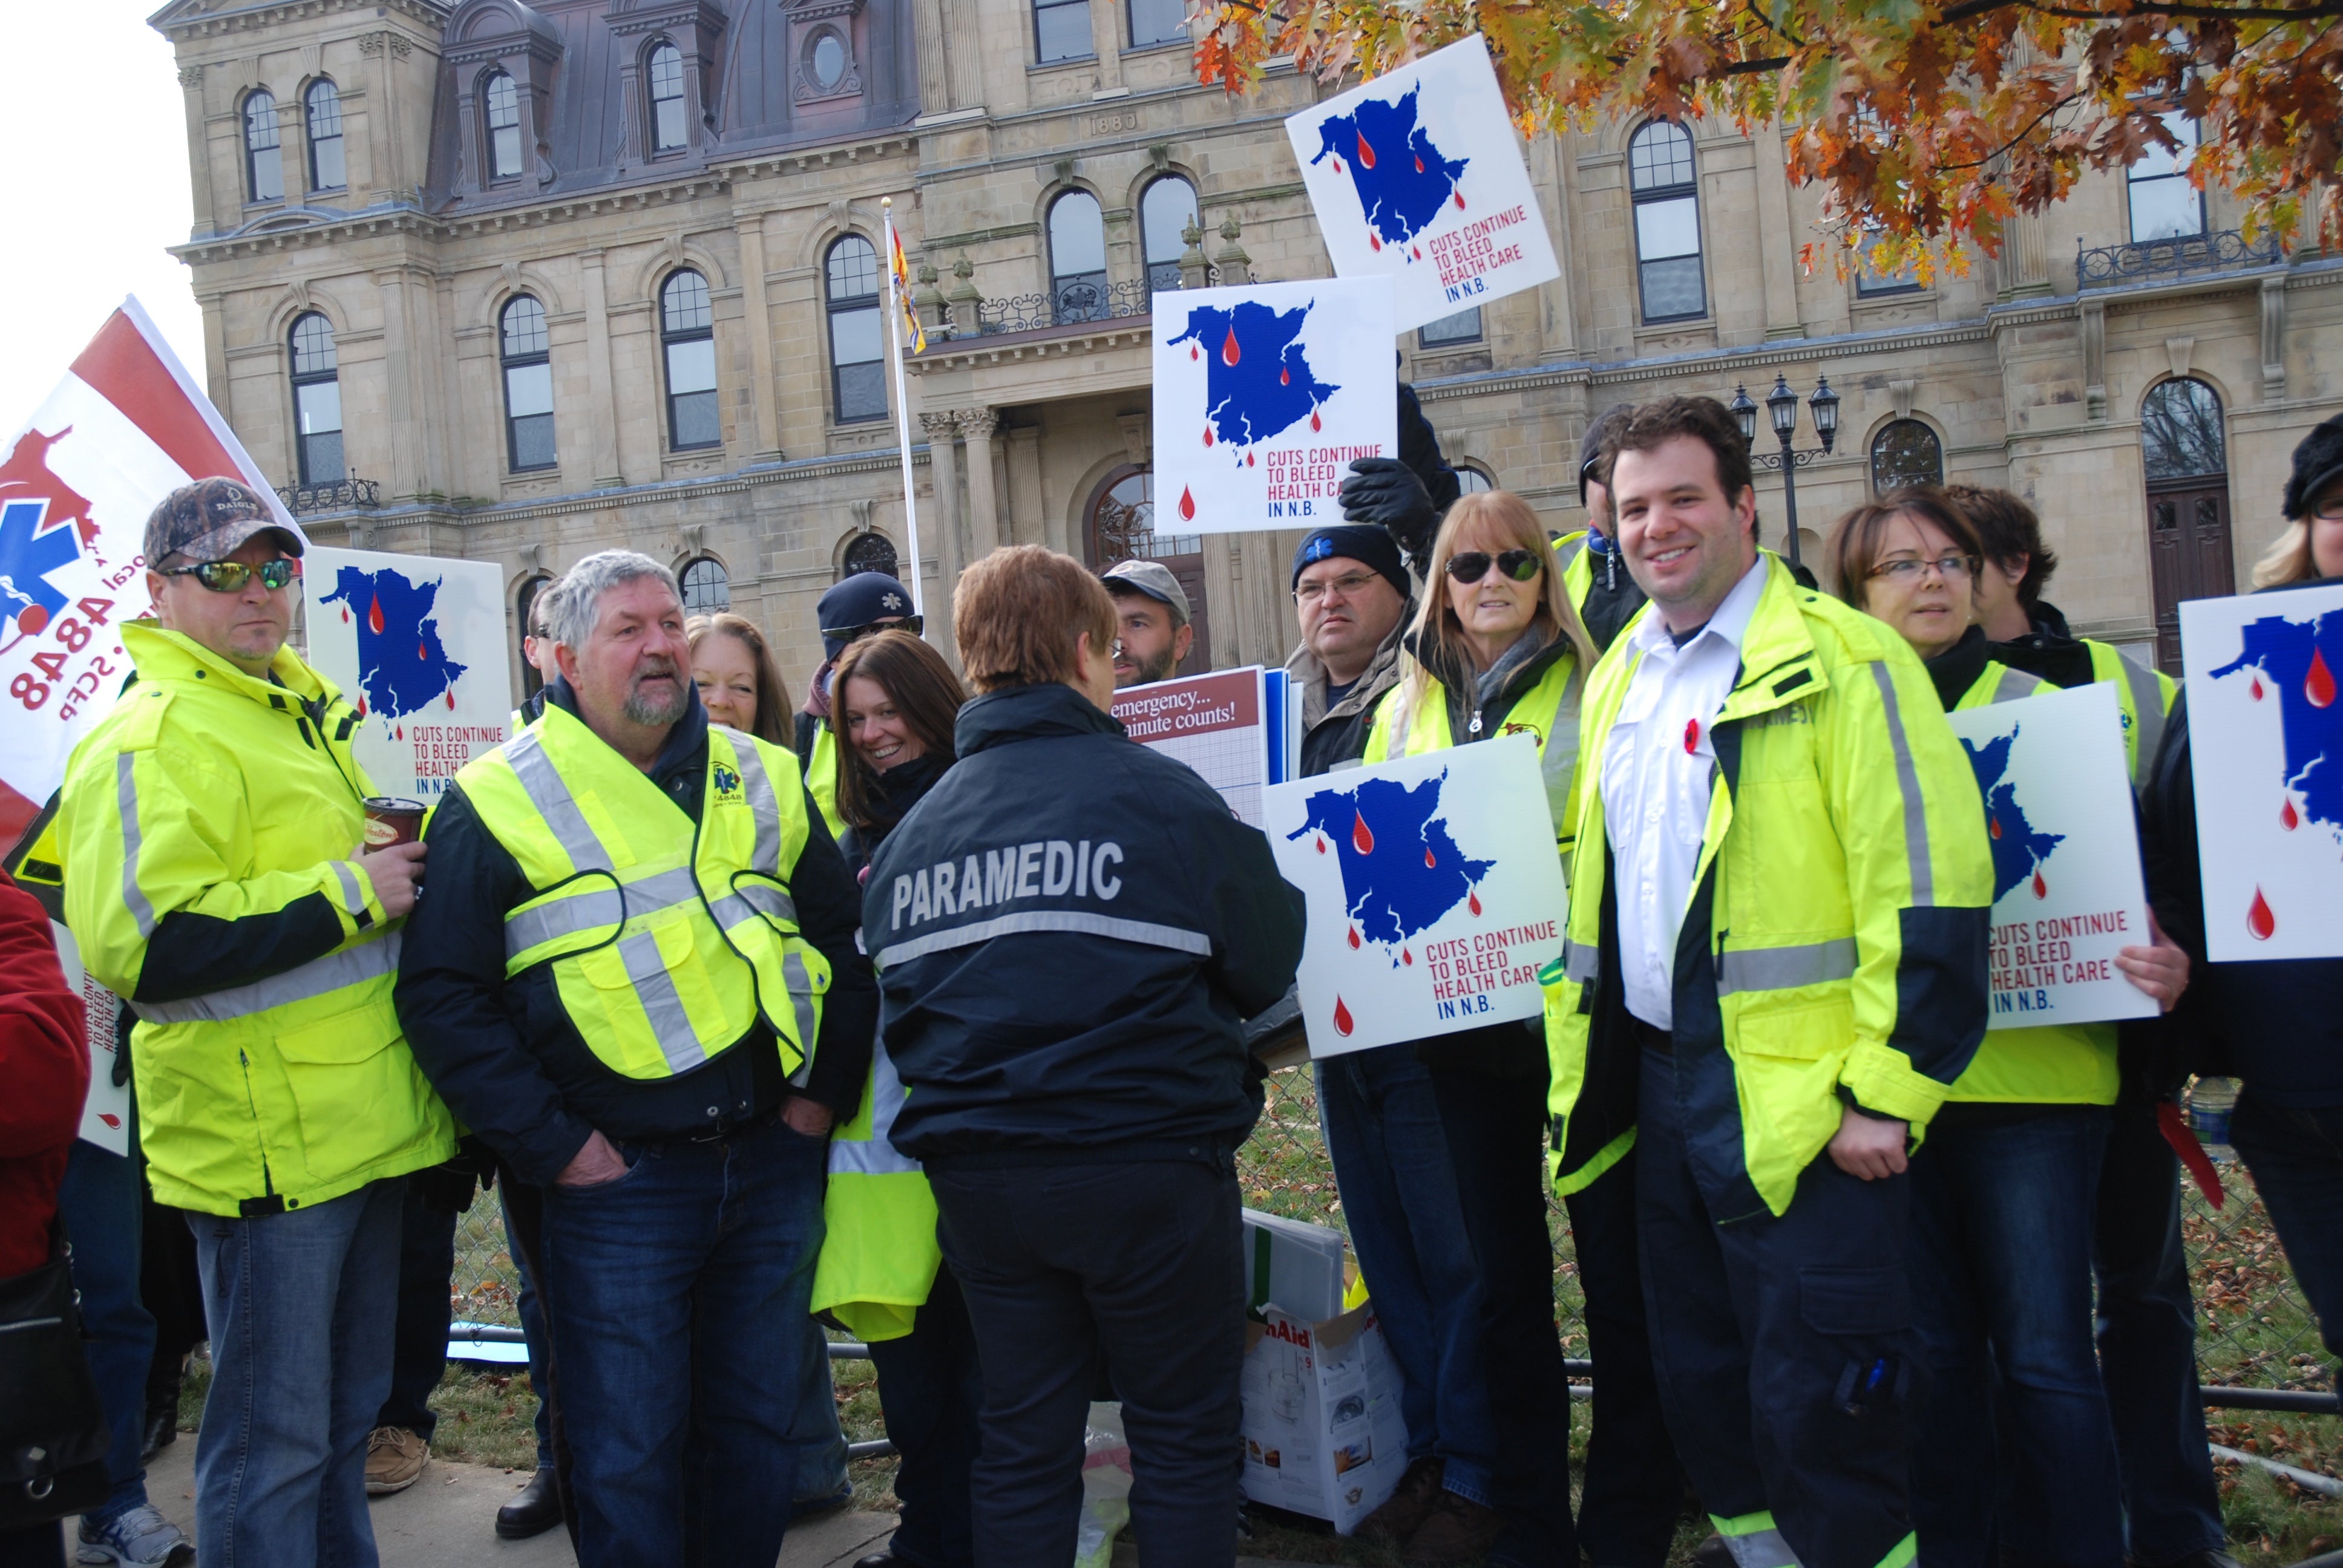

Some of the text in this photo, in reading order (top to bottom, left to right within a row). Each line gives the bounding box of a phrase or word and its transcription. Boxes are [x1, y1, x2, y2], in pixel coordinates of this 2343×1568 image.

[1091, 114, 1136, 134] 1880
[1430, 205, 1527, 255] CUTS CONTINUE
[1434, 238, 1492, 270] TO BLEED
[1440, 244, 1523, 287] HEALTH CARE
[1446, 277, 1489, 303] IN N.B.
[1268, 445, 1382, 466] CUTS CONTINUE
[1267, 465, 1335, 483] TO BLEED
[1268, 481, 1343, 500] HEALTH CA
[216, 501, 258, 511] DAIGLE
[1269, 500, 1317, 518] IN N.B.
[1110, 691, 1211, 719] emergency...
[1175, 701, 1235, 730] counts!
[413, 727, 503, 742] CUTS CONTINUE
[414, 744, 468, 759] TO BLEED
[416, 761, 457, 777] HEALTH
[417, 779, 428, 794] IN
[891, 840, 1124, 930] PARAMEDIC
[2036, 910, 2128, 941] CONTINUE
[1426, 920, 1558, 962] CUTS CONTINUE
[1989, 941, 2071, 969] TO BLEED
[1429, 950, 1508, 981] TO BLEED
[1991, 959, 2111, 991] HEALTH CARE
[84, 968, 94, 1008] CONTI
[1434, 973, 1495, 1001] HEALTH
[1437, 995, 1495, 1020] IN N.B.
[1994, 990, 2054, 1013] IN N.B.
[94, 991, 104, 1047] TO BLEED
[104, 990, 114, 1053] HEALTH CA
[1305, 1356, 1311, 1368] 9
